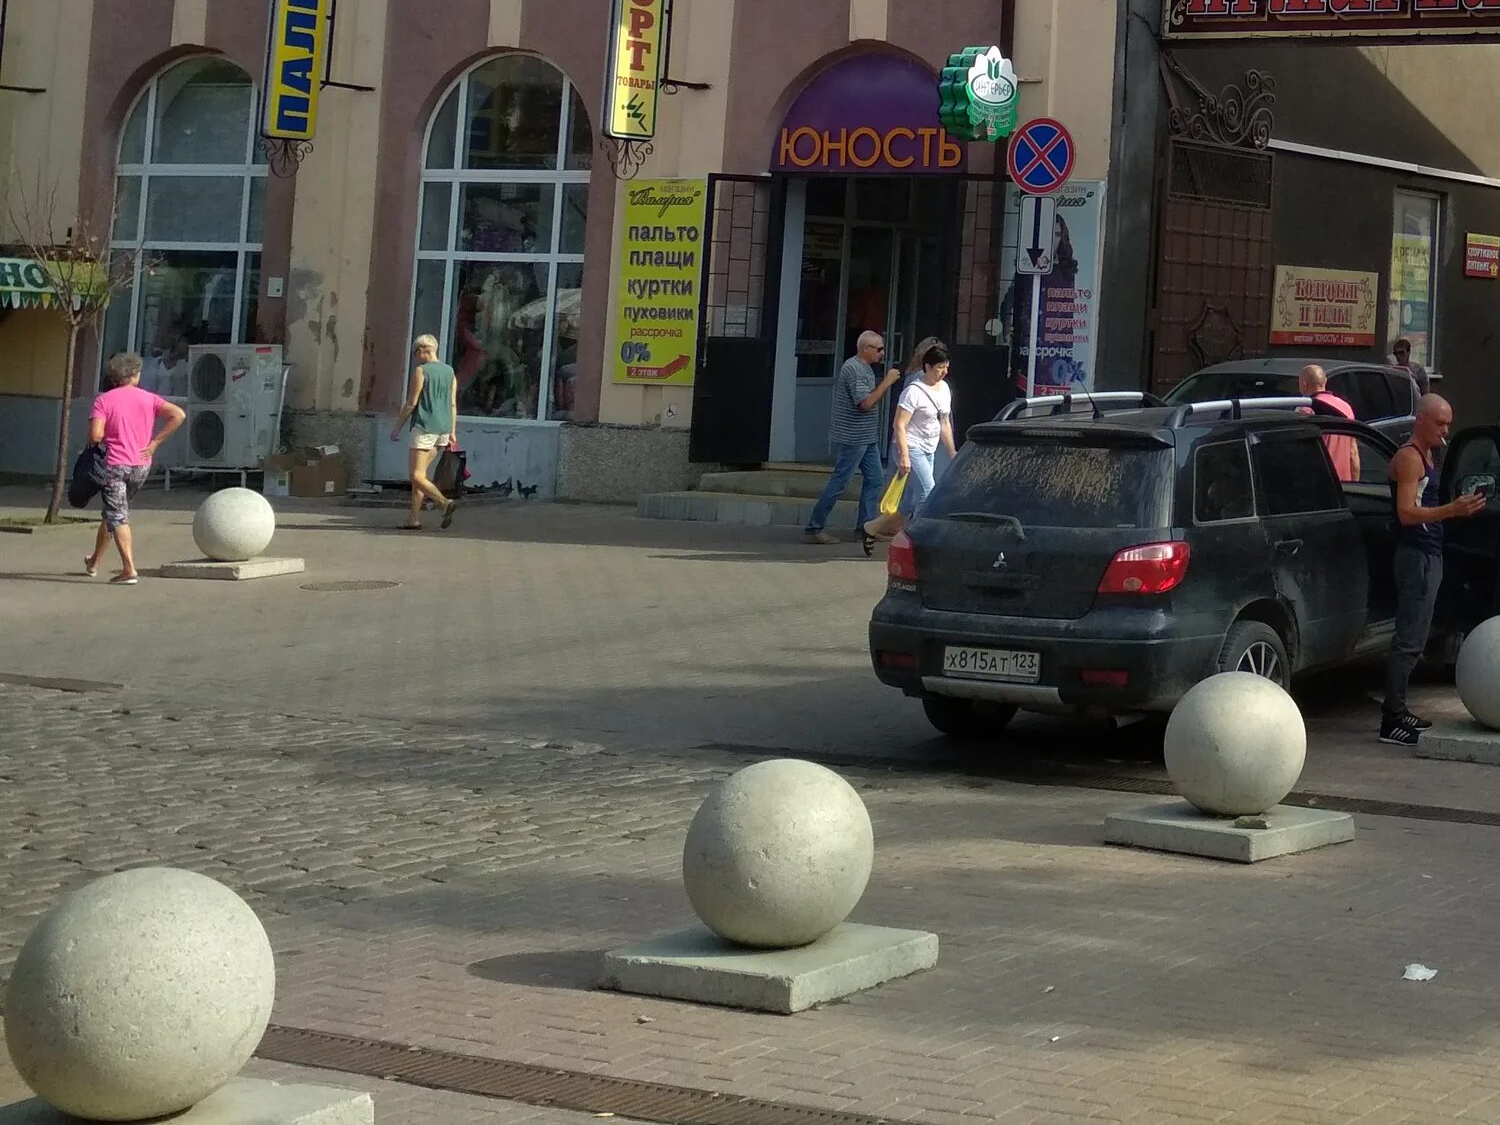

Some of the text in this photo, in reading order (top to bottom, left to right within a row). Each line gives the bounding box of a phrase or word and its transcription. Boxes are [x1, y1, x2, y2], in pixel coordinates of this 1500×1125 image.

[617, 76, 656, 90] ТОВАРЫ
[779, 126, 962, 168] ЮНОСТЬ
[660, 185, 695, 193] магазин
[628, 226, 699, 242] пальто
[630, 251, 695, 270] плащи
[627, 279, 693, 299] куртки
[1047, 287, 1092, 299] пальто
[624, 306, 693, 323] пуховики
[630, 327, 682, 339] рассрочка
[621, 341, 651, 364] 0%
[1053, 360, 1086, 383] 0%
